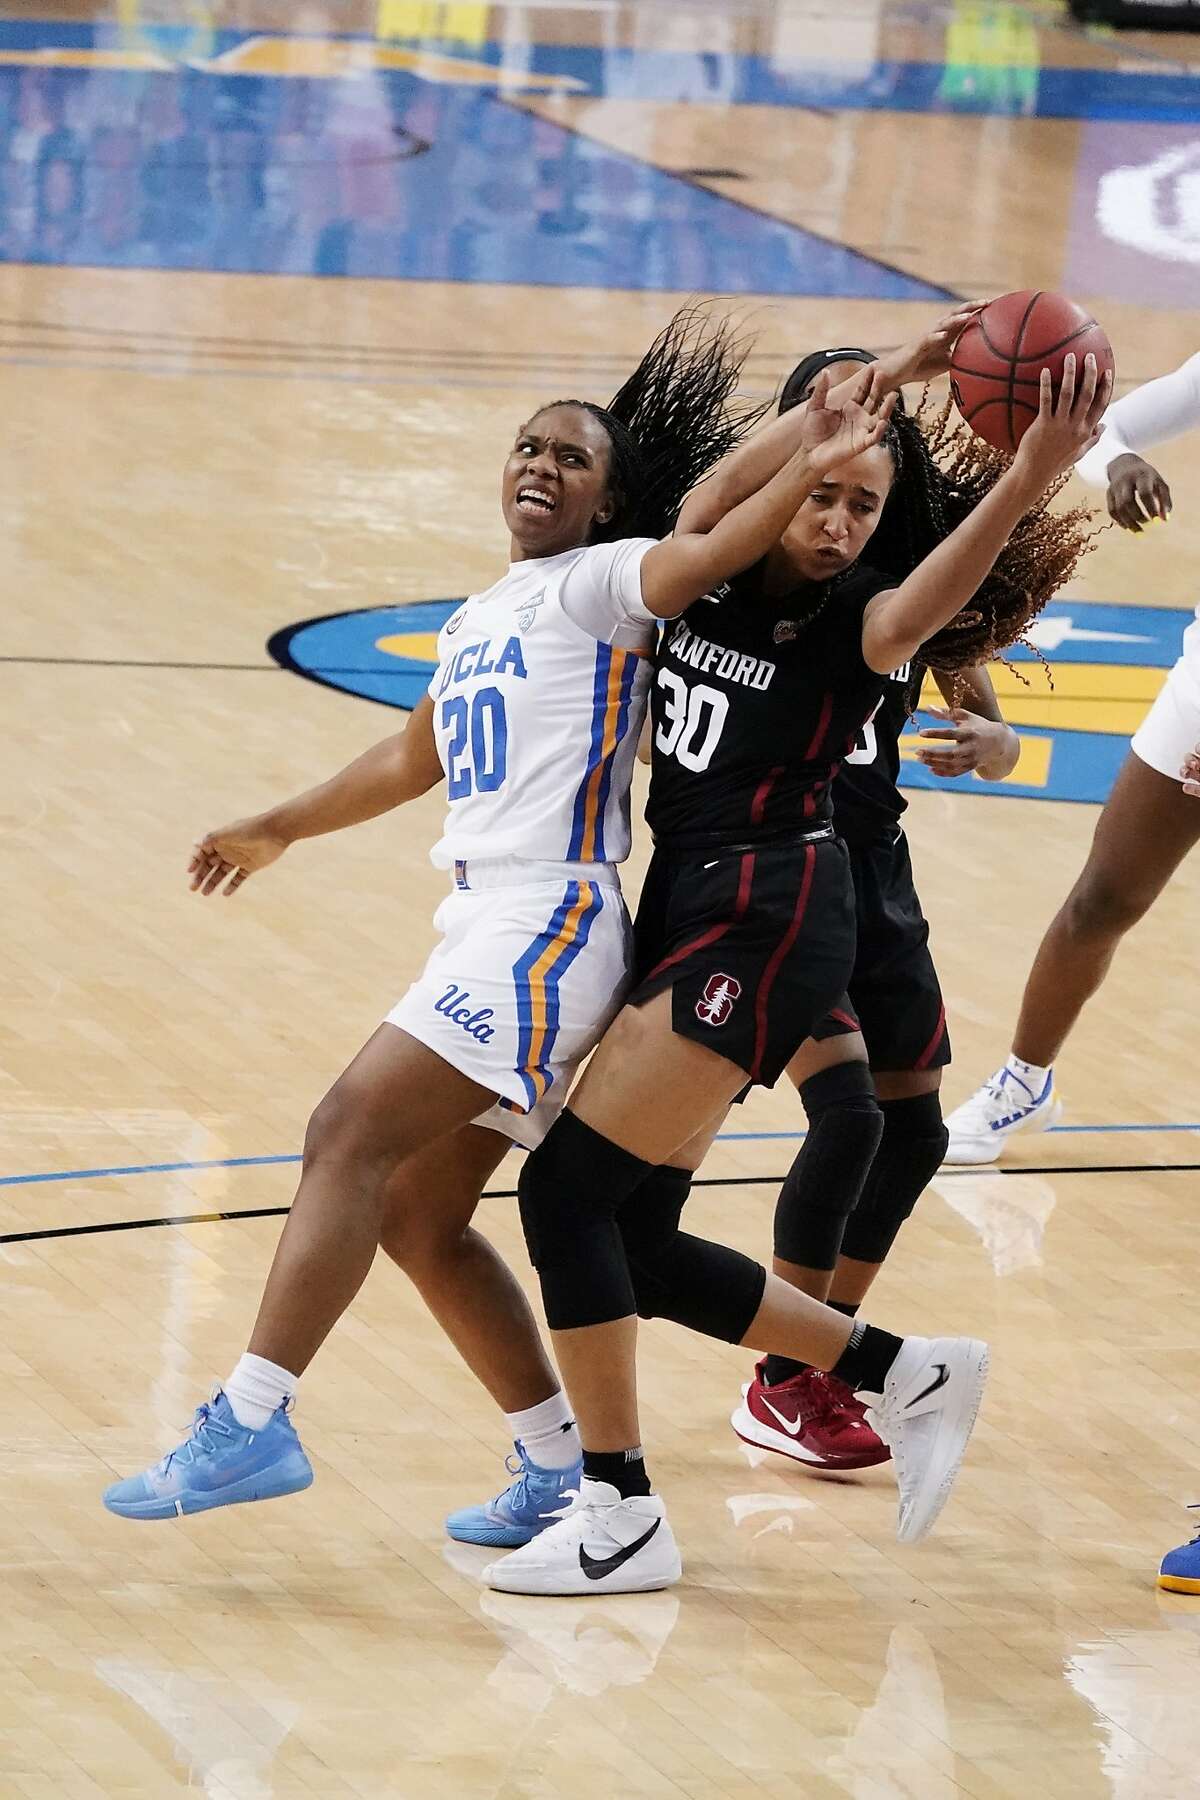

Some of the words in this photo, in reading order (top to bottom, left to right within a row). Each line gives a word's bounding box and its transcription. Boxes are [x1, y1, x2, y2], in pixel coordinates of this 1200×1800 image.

[438, 636, 528, 698] UCLA
[668, 620, 776, 691] SANFORD
[442, 687, 507, 801] 20
[656, 667, 729, 773] 30
[435, 984, 494, 1043] Ucla
